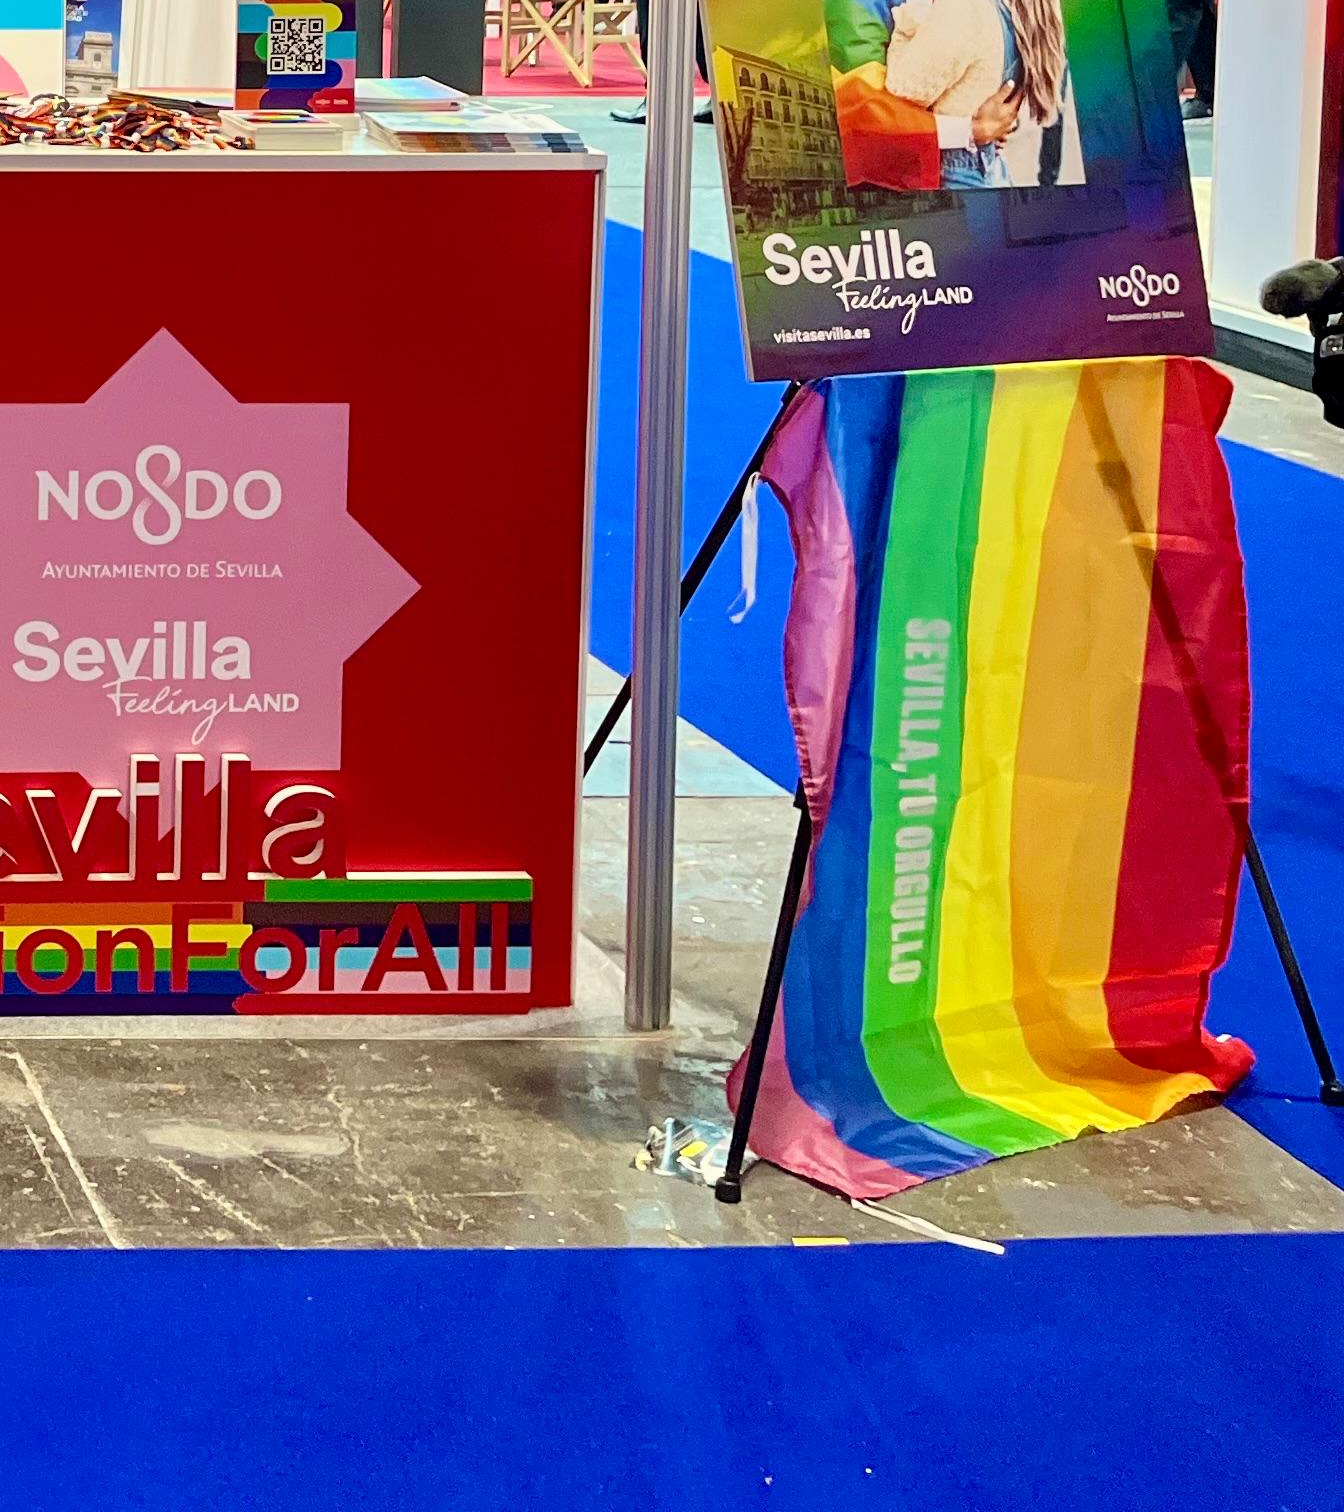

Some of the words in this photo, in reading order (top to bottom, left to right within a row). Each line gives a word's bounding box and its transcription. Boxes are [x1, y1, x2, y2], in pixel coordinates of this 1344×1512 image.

[762, 228, 937, 286] Sevilla
[773, 327, 871, 344] visitasevilla.es
[42, 561, 180, 579] AYUNTAMIENTO
[187, 563, 210, 578] DE
[215, 561, 283, 578] SEVILLA
[12, 620, 251, 682] Sevilla
[891, 618, 951, 772] SEVILLA,
[899, 774, 937, 816] TU
[888, 826, 934, 984] ORGULLO
